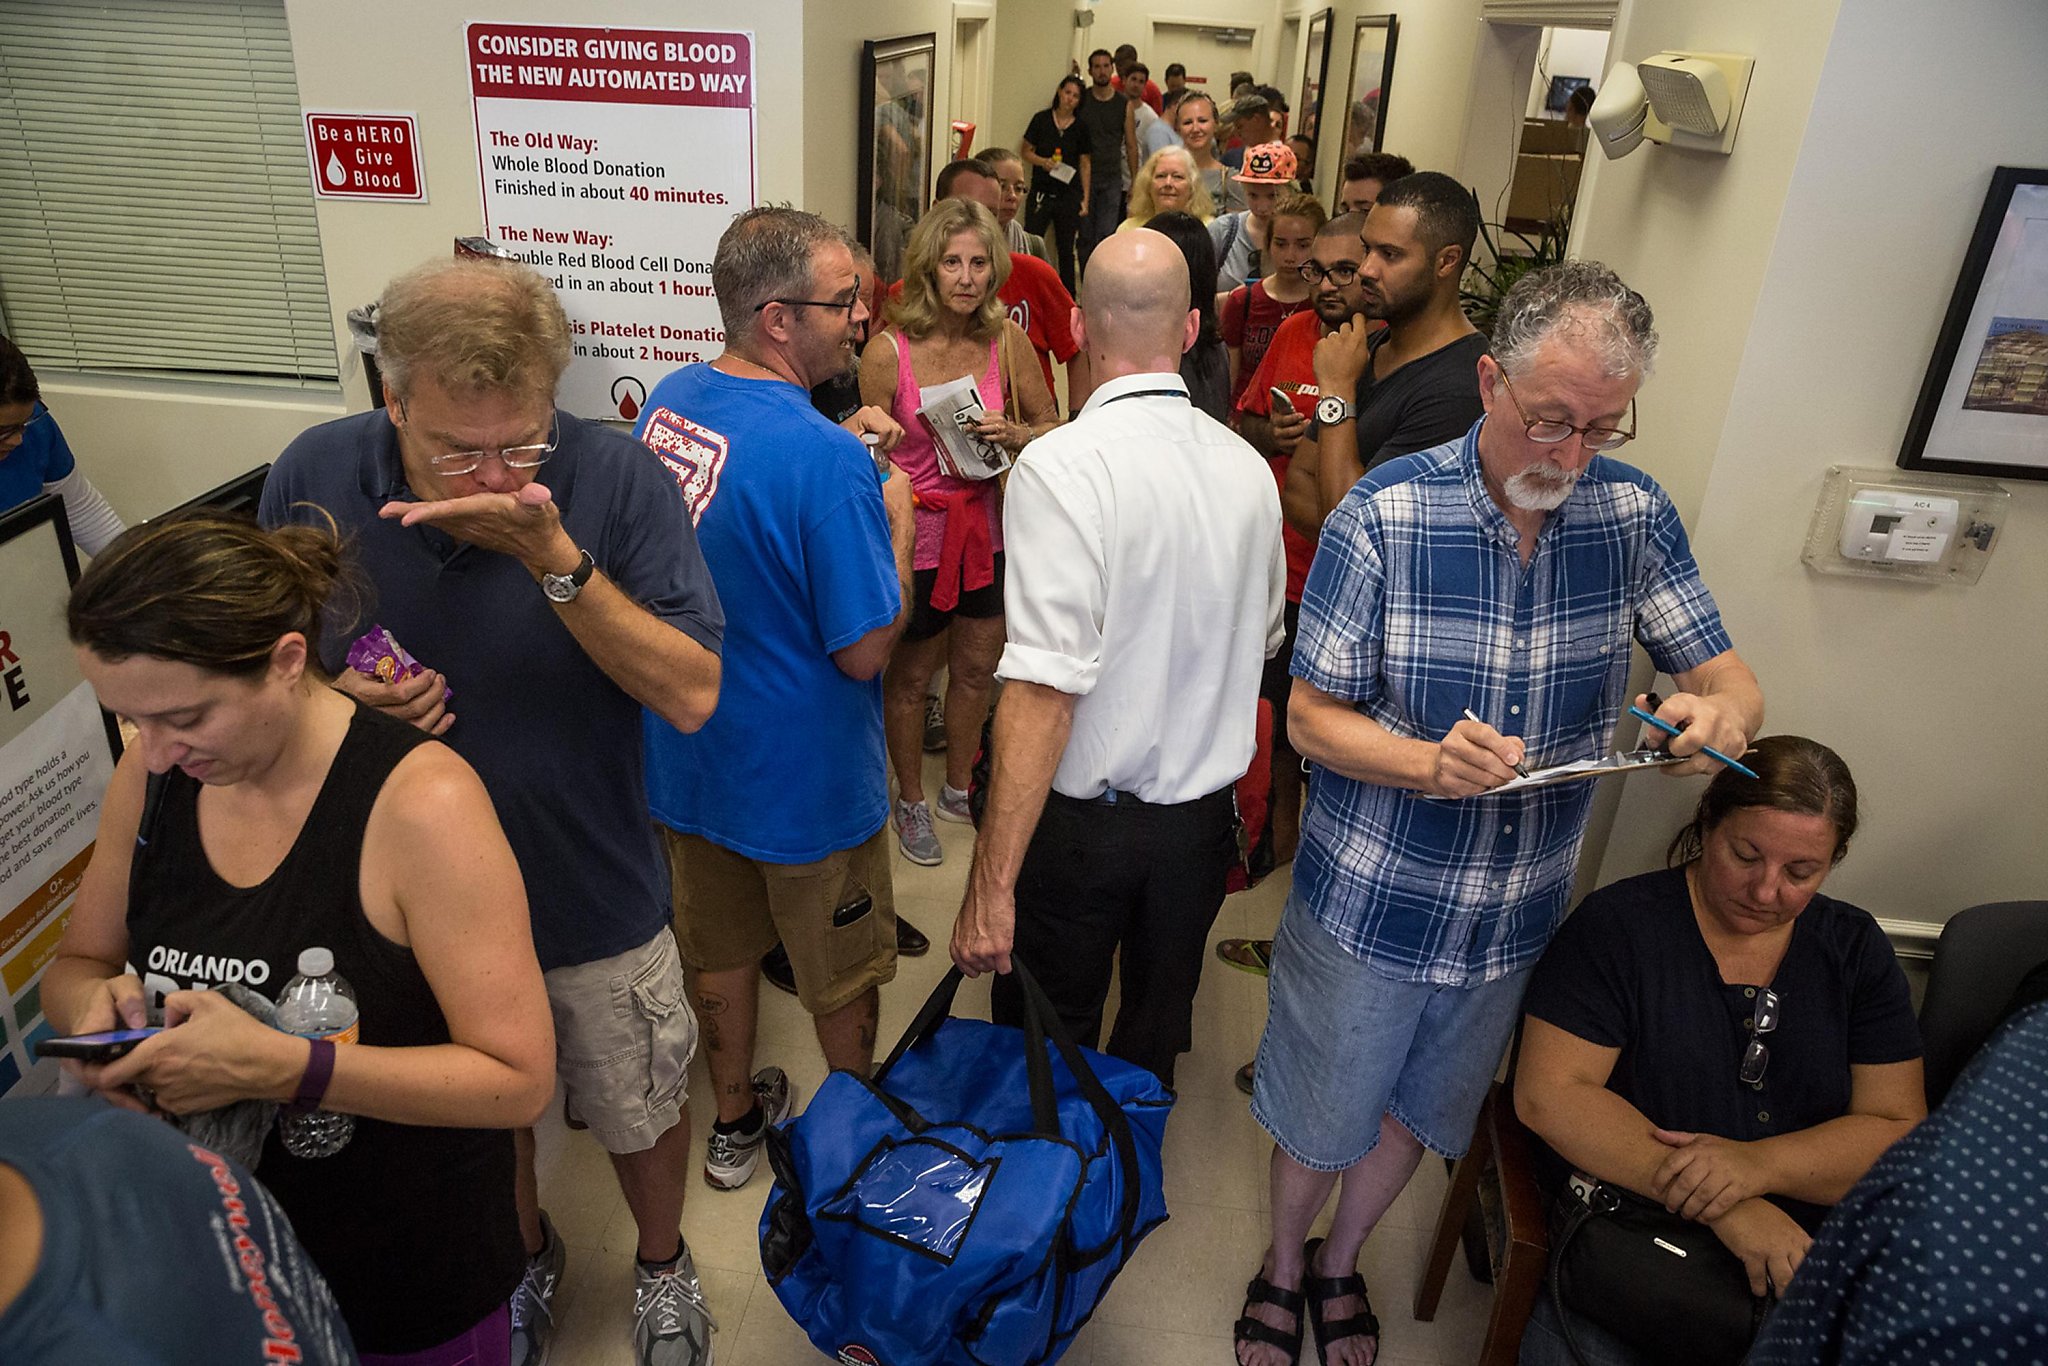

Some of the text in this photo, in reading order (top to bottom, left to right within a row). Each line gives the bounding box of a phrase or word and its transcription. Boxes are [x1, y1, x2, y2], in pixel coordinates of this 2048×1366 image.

[477, 34, 737, 64] CONSIDER GIVING BLOOD
[476, 63, 747, 94] THE NEW AUTOMATED WAY
[317, 123, 404, 144] Be a HERO
[489, 130, 599, 155] The Old Way:
[355, 147, 393, 166] Give
[492, 154, 665, 178] Whole Blood Donation
[353, 170, 401, 188] Blood
[495, 178, 729, 205] Finished in about 40 minutes.
[498, 225, 614, 250] The New Way:
[507, 249, 713, 274] ouble Red Blood Cell Dona
[568, 274, 582, 290] in
[586, 278, 605, 292] an
[609, 277, 654, 294] about
[658, 280, 667, 295] 1
[672, 280, 715, 297] hour.
[590, 321, 655, 339] Platelet
[659, 325, 725, 343] Donatio
[574, 341, 704, 364] in about 2 hours.
[0, 664, 31, 712] E
[14, 775, 35, 796] type
[35, 755, 60, 780] holds
[61, 749, 67, 761] a
[28, 787, 45, 805] Ask
[45, 777, 57, 792] us
[56, 763, 75, 782] how
[75, 749, 91, 769] you
[15, 811, 36, 835] your
[37, 788, 63, 815] blood
[63, 775, 82, 796] type
[11, 833, 32, 854] best
[33, 801, 72, 838] donation
[14, 851, 31, 873] and
[32, 835, 54, 858] save
[53, 816, 76, 840] more
[76, 799, 99, 821] lives.
[147, 944, 270, 986] ORLANDO
